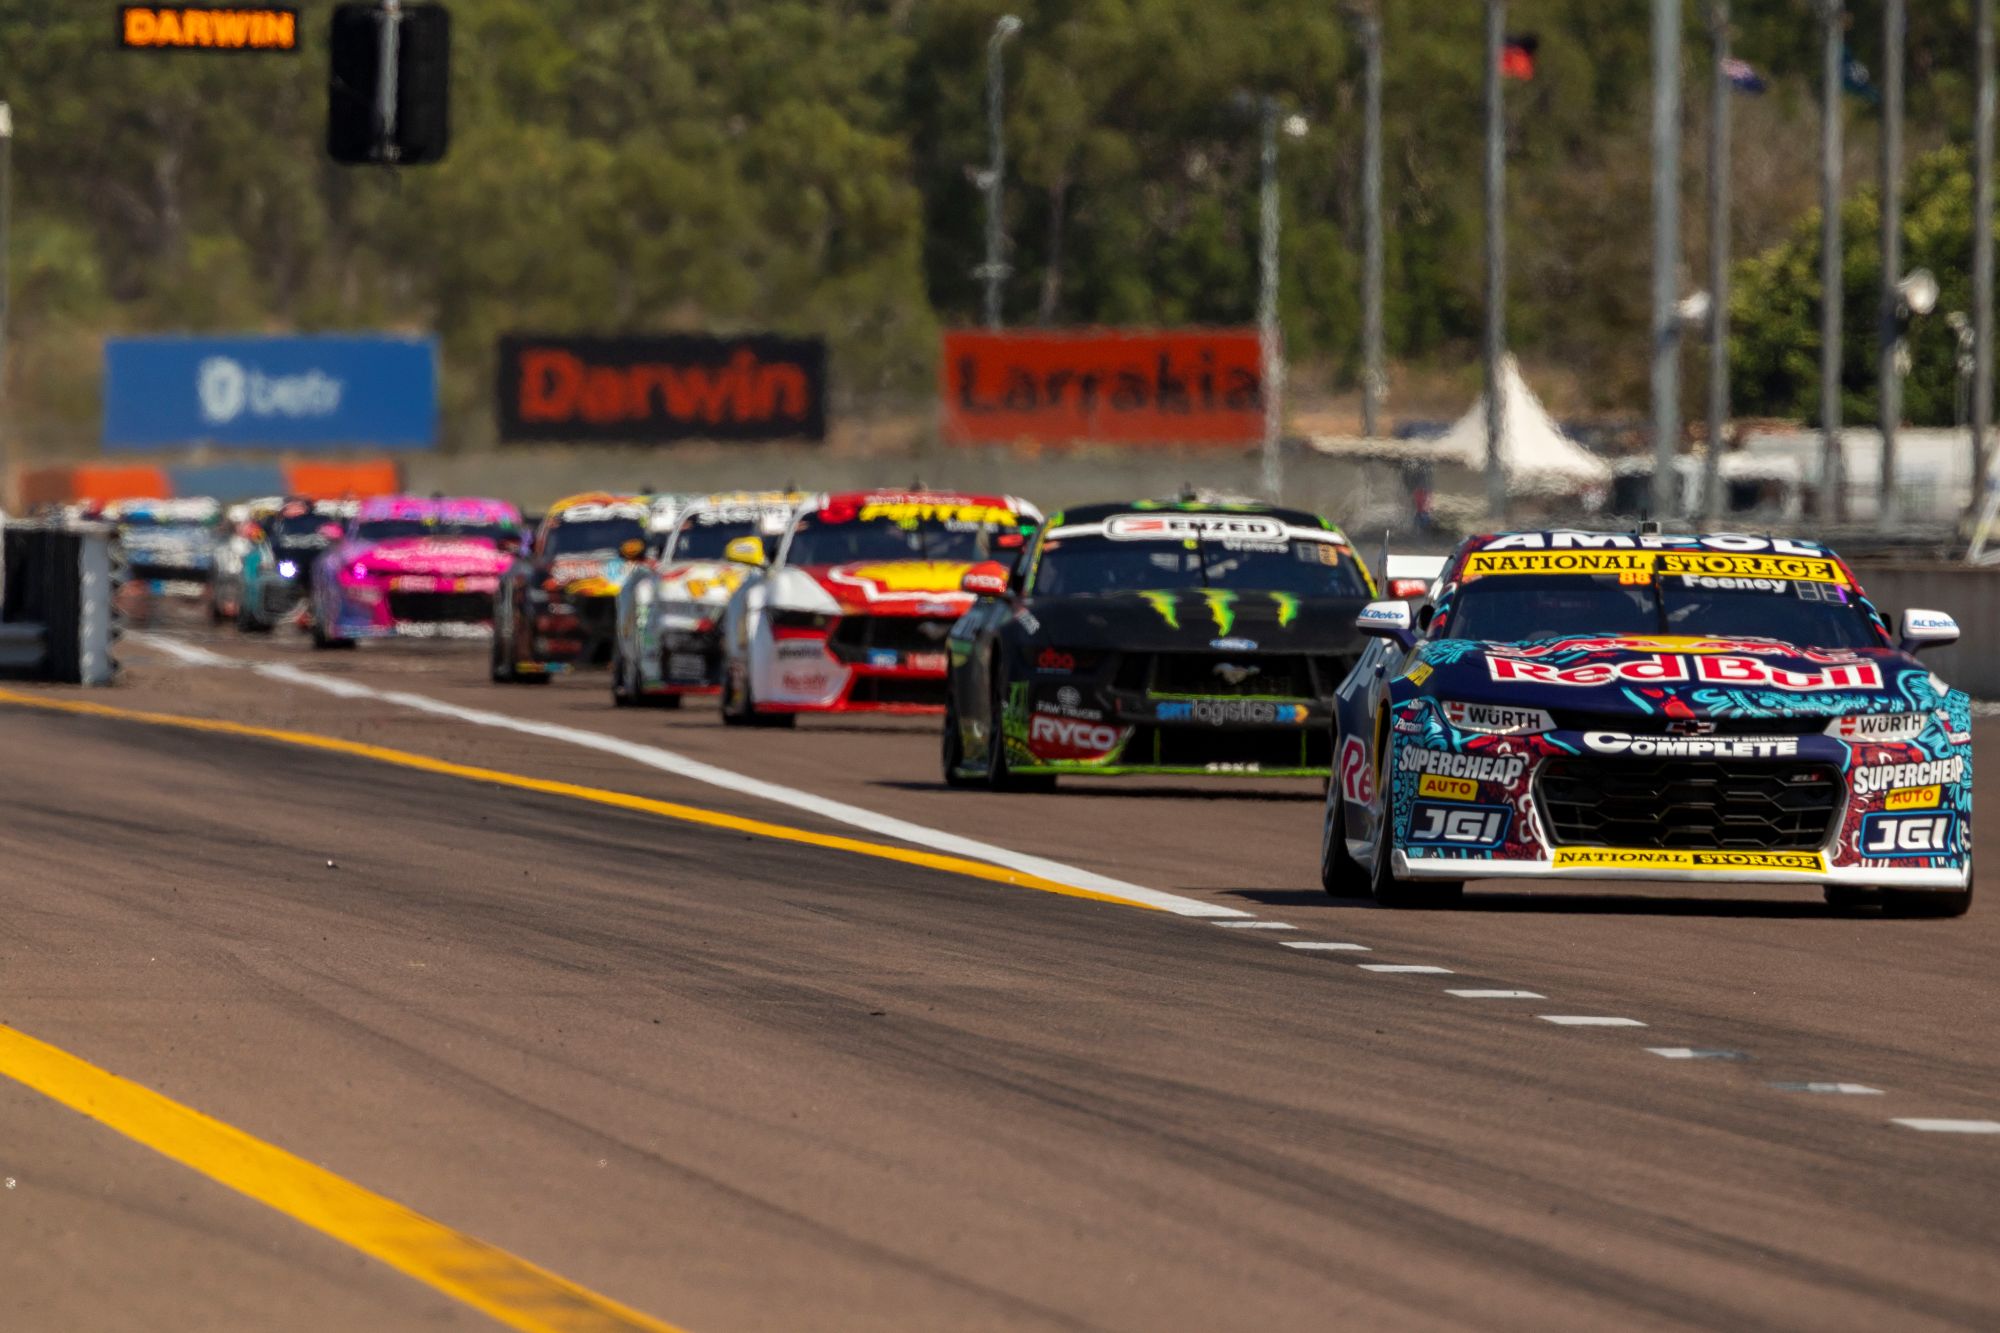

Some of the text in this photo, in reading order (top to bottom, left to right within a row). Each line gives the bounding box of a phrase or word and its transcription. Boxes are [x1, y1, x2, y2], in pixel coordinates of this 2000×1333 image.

[124, 7, 296, 48] DARWIN
[518, 348, 810, 423] Darwin
[957, 349, 1263, 414] Larrakia
[1169, 520, 1268, 534] ENZED
[1483, 532, 1822, 557] AMPOL
[1474, 555, 1830, 579] NATIONAL STORAGE
[1618, 571, 1651, 585] 88
[1682, 574, 1787, 594] Feeney
[1359, 608, 1404, 620] ACDelco
[1484, 652, 1884, 692] Red Bull
[1192, 698, 1276, 726] logistics
[1469, 706, 1541, 729] WÜRTH
[1860, 713, 1922, 734] WÜRTH
[1032, 716, 1117, 750] RYCO
[1583, 731, 1798, 758] COMPLETE
[1398, 744, 1526, 785] SUPERCHEAP
[1853, 755, 1964, 795] SUPERCHEAP
[1425, 779, 1471, 795] AUTO
[1891, 789, 1934, 804] AUTO
[1412, 809, 1502, 842] JGI
[1868, 817, 1948, 851] JGI
[1558, 851, 1816, 868] NATIONAL STORAGE
